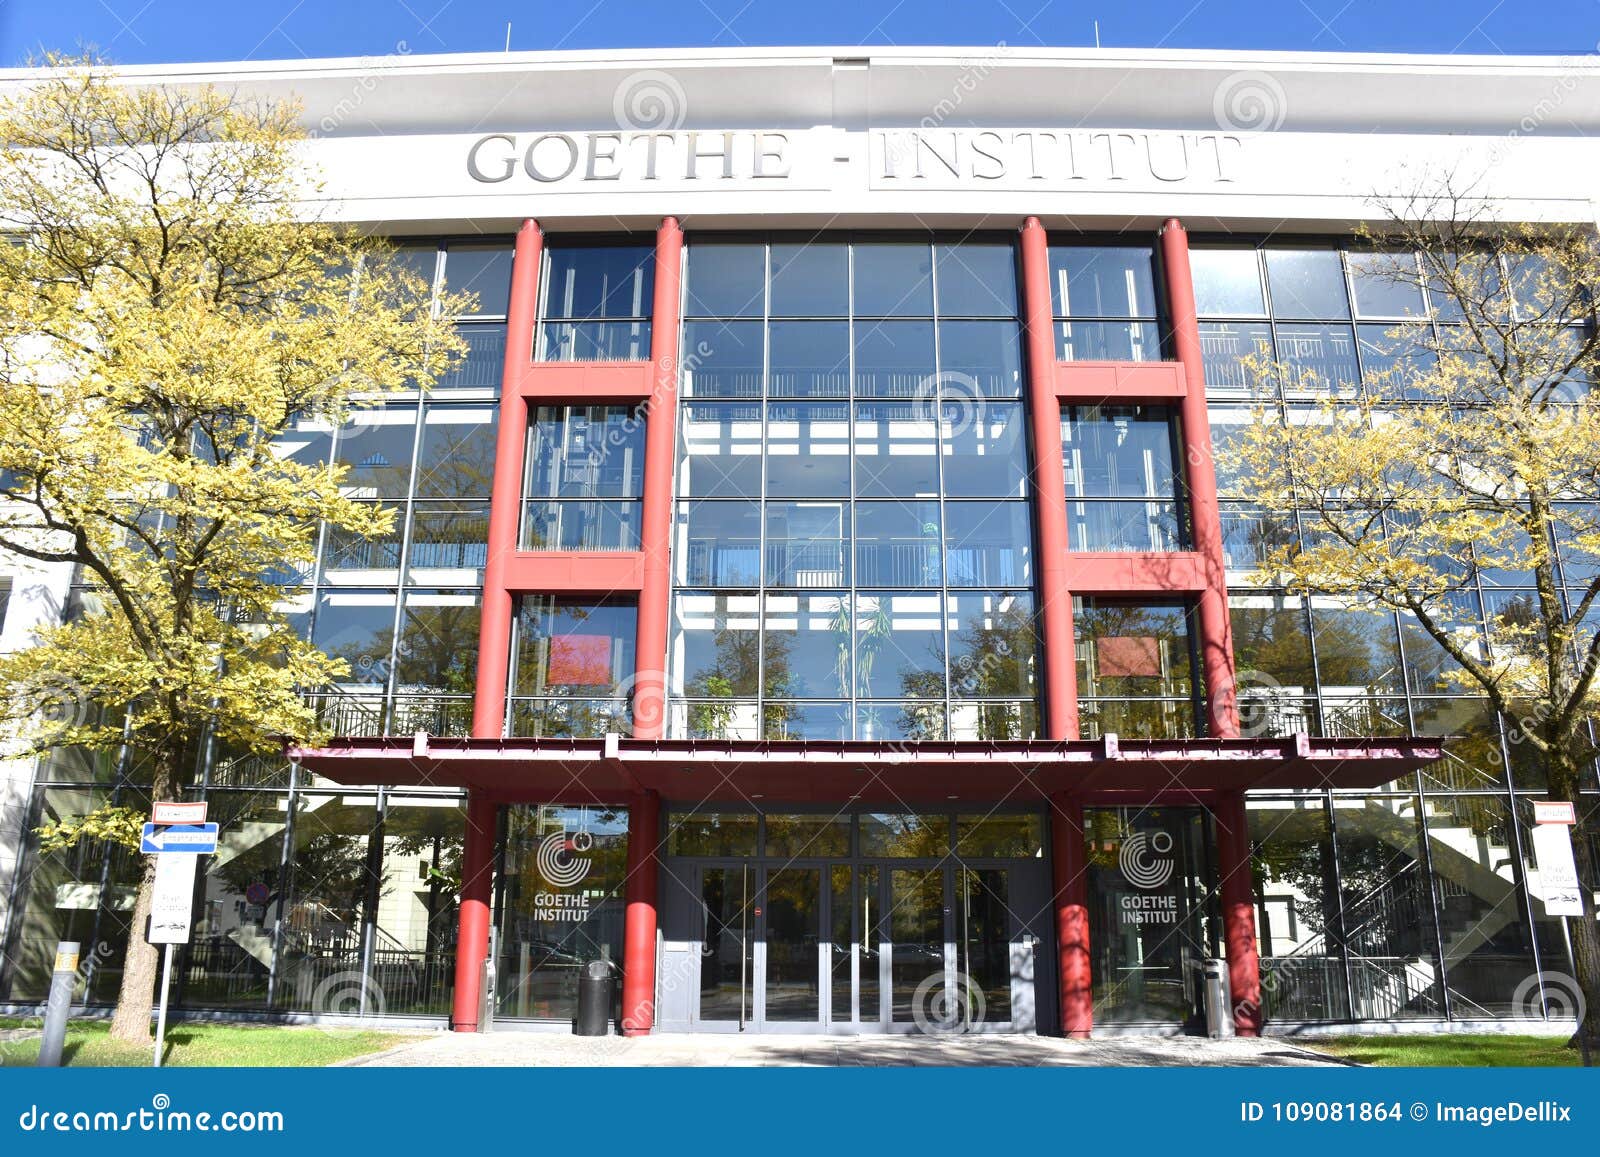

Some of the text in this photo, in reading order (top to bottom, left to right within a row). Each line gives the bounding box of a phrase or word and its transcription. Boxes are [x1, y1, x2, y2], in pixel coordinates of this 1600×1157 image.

[466, 132, 791, 183] GOETHE
[879, 131, 1242, 183] INSTITUT
[534, 894, 590, 907] GOETHE
[1121, 896, 1177, 909] GOETHE
[534, 908, 590, 921] INSTITUT
[1122, 910, 1178, 923] INSTITUT
